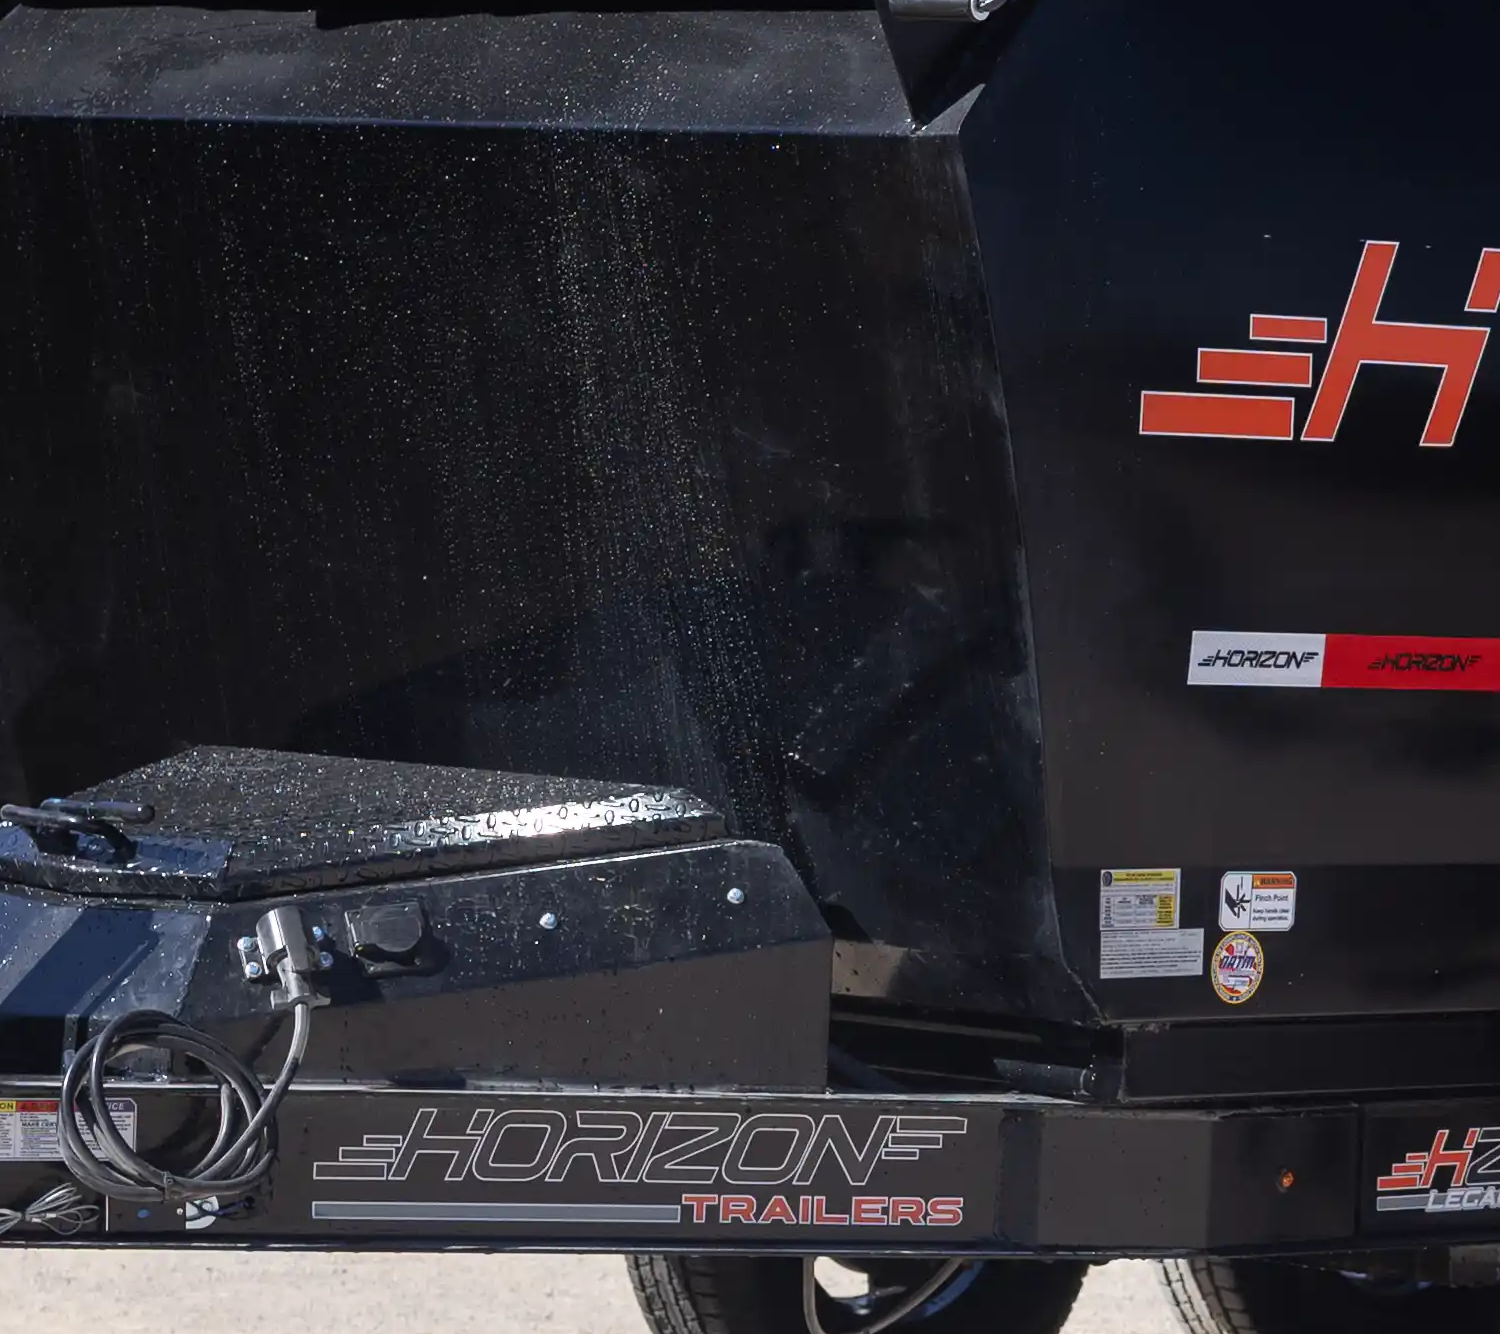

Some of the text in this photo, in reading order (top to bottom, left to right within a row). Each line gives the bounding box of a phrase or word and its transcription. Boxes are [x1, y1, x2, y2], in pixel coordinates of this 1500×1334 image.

[1210, 649, 1470, 672] HORIZON HORIZON
[1273, 894, 1289, 902] Point
[388, 1108, 897, 1185] HORIZON
[682, 1193, 964, 1225] TRAILERS
